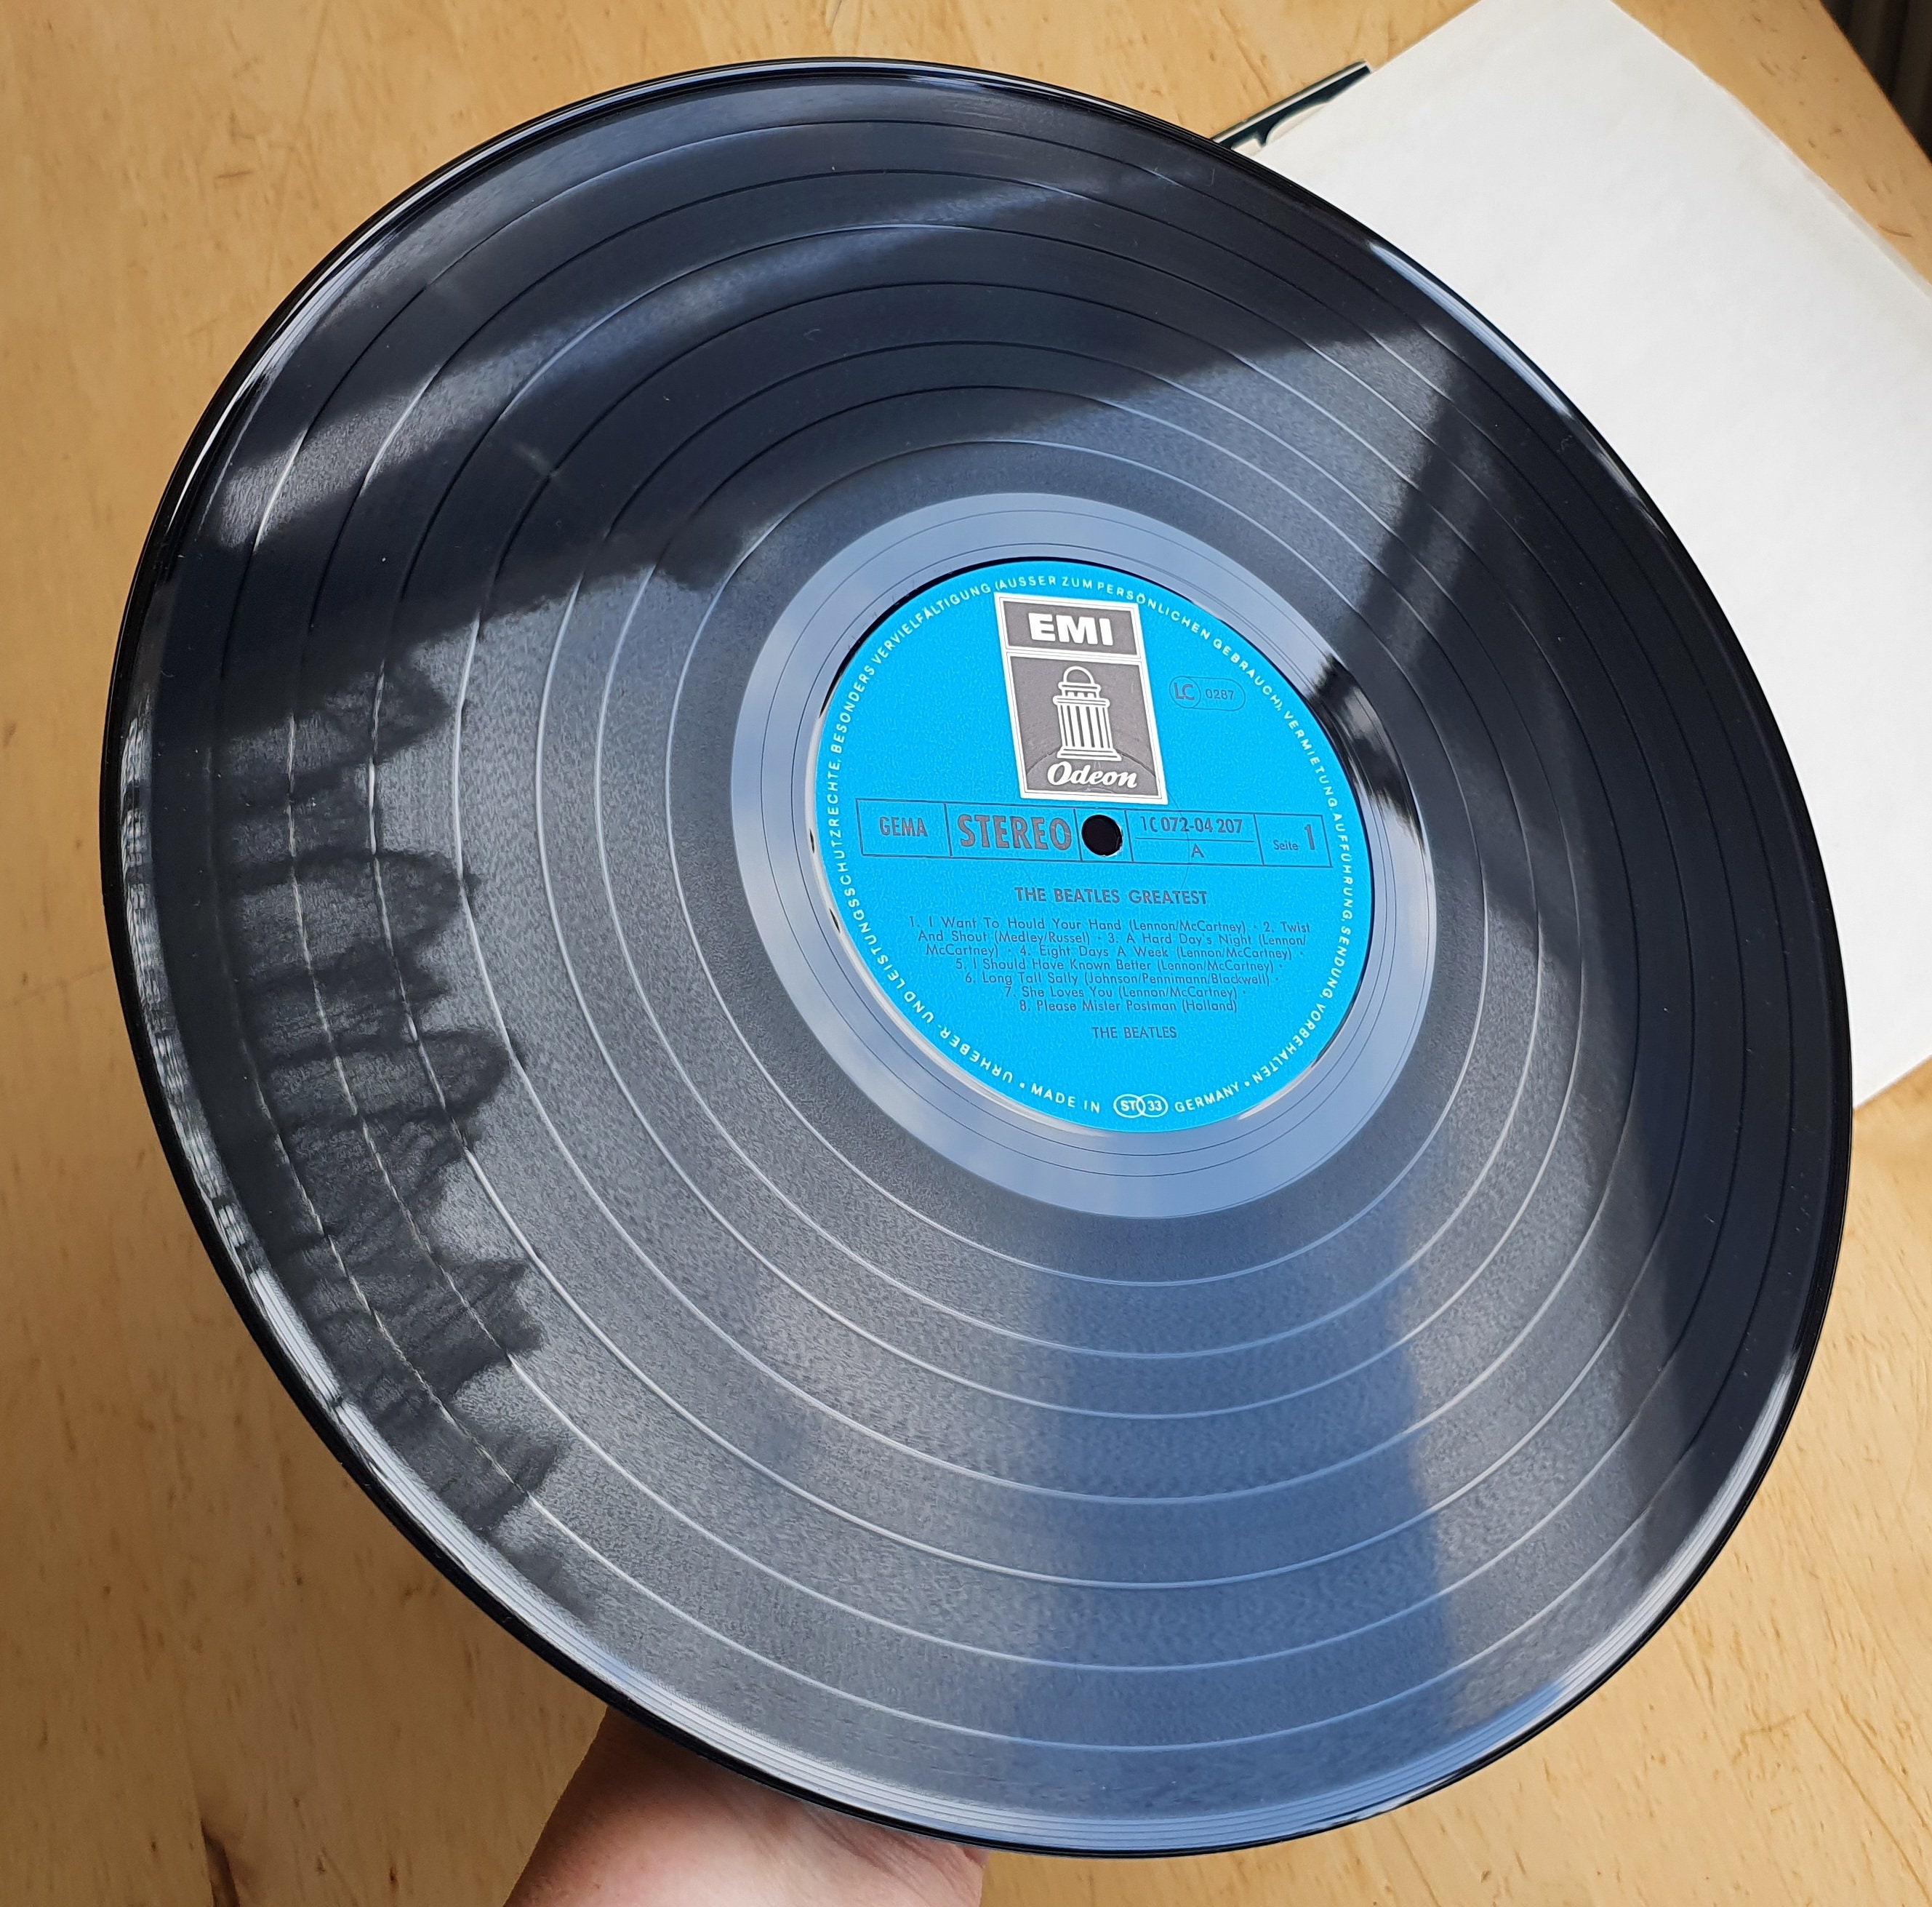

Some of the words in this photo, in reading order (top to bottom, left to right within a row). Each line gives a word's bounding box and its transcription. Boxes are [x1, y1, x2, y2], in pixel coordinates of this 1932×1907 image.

[995, 576, 1057, 591] (AUSSER
[1062, 576, 1093, 589] ZUM
[1097, 582, 1211, 640] PERSÖNLICHEN
[871, 584, 991, 664] VERVIELFÄLTIGUNG
[1028, 612, 1113, 645] EMI
[1174, 682, 1195, 701] LC
[1206, 689, 1234, 700] 0287
[830, 665, 875, 754] BESONDERS
[1047, 761, 1137, 788] Odeon
[879, 816, 928, 836] GEMA
[958, 814, 1072, 850] STEREO
[1216, 818, 1243, 833] 207
[1273, 839, 1299, 851] Seite
[1304, 824, 1315, 850] 1
[1191, 844, 1204, 857] A
[1014, 887, 1046, 901] THE
[1054, 888, 1120, 903] BEATLES
[1128, 889, 1207, 905] GREATEST
[910, 916, 920, 927] 1.
[941, 916, 977, 928] Want
[984, 917, 999, 929] To
[1008, 918, 1045, 929] Hould
[1052, 919, 1081, 929] Your
[1089, 919, 1121, 930] Hand
[1129, 919, 1246, 934] (Lennon/McCartney)
[1263, 921, 1274, 932] 2.
[1280, 921, 1310, 933] Twist
[918, 930, 943, 942] And
[951, 931, 987, 942] Shout
[995, 931, 1091, 945] (Medley/Russel)
[1107, 933, 1118, 943] 3.
[1127, 934, 1136, 943] A
[1142, 933, 1171, 944] Hard
[1179, 934, 1212, 946] Day's
[1219, 935, 1251, 946] Night
[1259, 935, 1306, 946] (Lennon/
[926, 944, 998, 957] McCartney)
[1019, 945, 1031, 956] 4.
[1040, 945, 1070, 959] Eight
[1079, 946, 1108, 958] Days
[1118, 948, 1126, 956] A
[1134, 948, 1169, 957] Week
[1177, 947, 1292, 960] (Lennon/McCartney)
[955, 959, 966, 970] 5.
[983, 959, 1026, 970] Should
[1032, 959, 1064, 970] Have
[1070, 959, 1110, 970] Known
[1116, 960, 1151, 970] Better
[1158, 960, 1274, 973] (Lennon/McCartney)
[966, 972, 975, 983] 6.
[983, 972, 1012, 986] Long
[1018, 972, 1041, 983] Tall
[1048, 972, 1078, 986] Sally
[1005, 986, 1016, 997] 7.
[1022, 986, 1044, 997] She
[1050, 986, 1083, 997] Loves
[1090, 986, 1113, 997] You
[1119, 986, 1237, 999] (Lennon/McCartney)
[904, 991, 934, 1023] UND
[1019, 1000, 1030, 1011] 8.
[1037, 1000, 1077, 1011] Please
[1082, 1000, 1121, 1011] Mister
[1127, 1001, 1177, 1011] Postman
[1182, 1000, 1238, 1012] (Holland)
[1092, 1026, 1118, 1039] THE
[1124, 1026, 1177, 1039] BEATLES
[1252, 1004, 1326, 1084] VORBEHALTEN
[1031, 1083, 1075, 1107] MADE
[1083, 1100, 1100, 1114] IN
[1121, 1099, 1137, 1112] ST
[1147, 1100, 1162, 1112] 33
[1174, 1082, 1240, 1112] GERMANY
